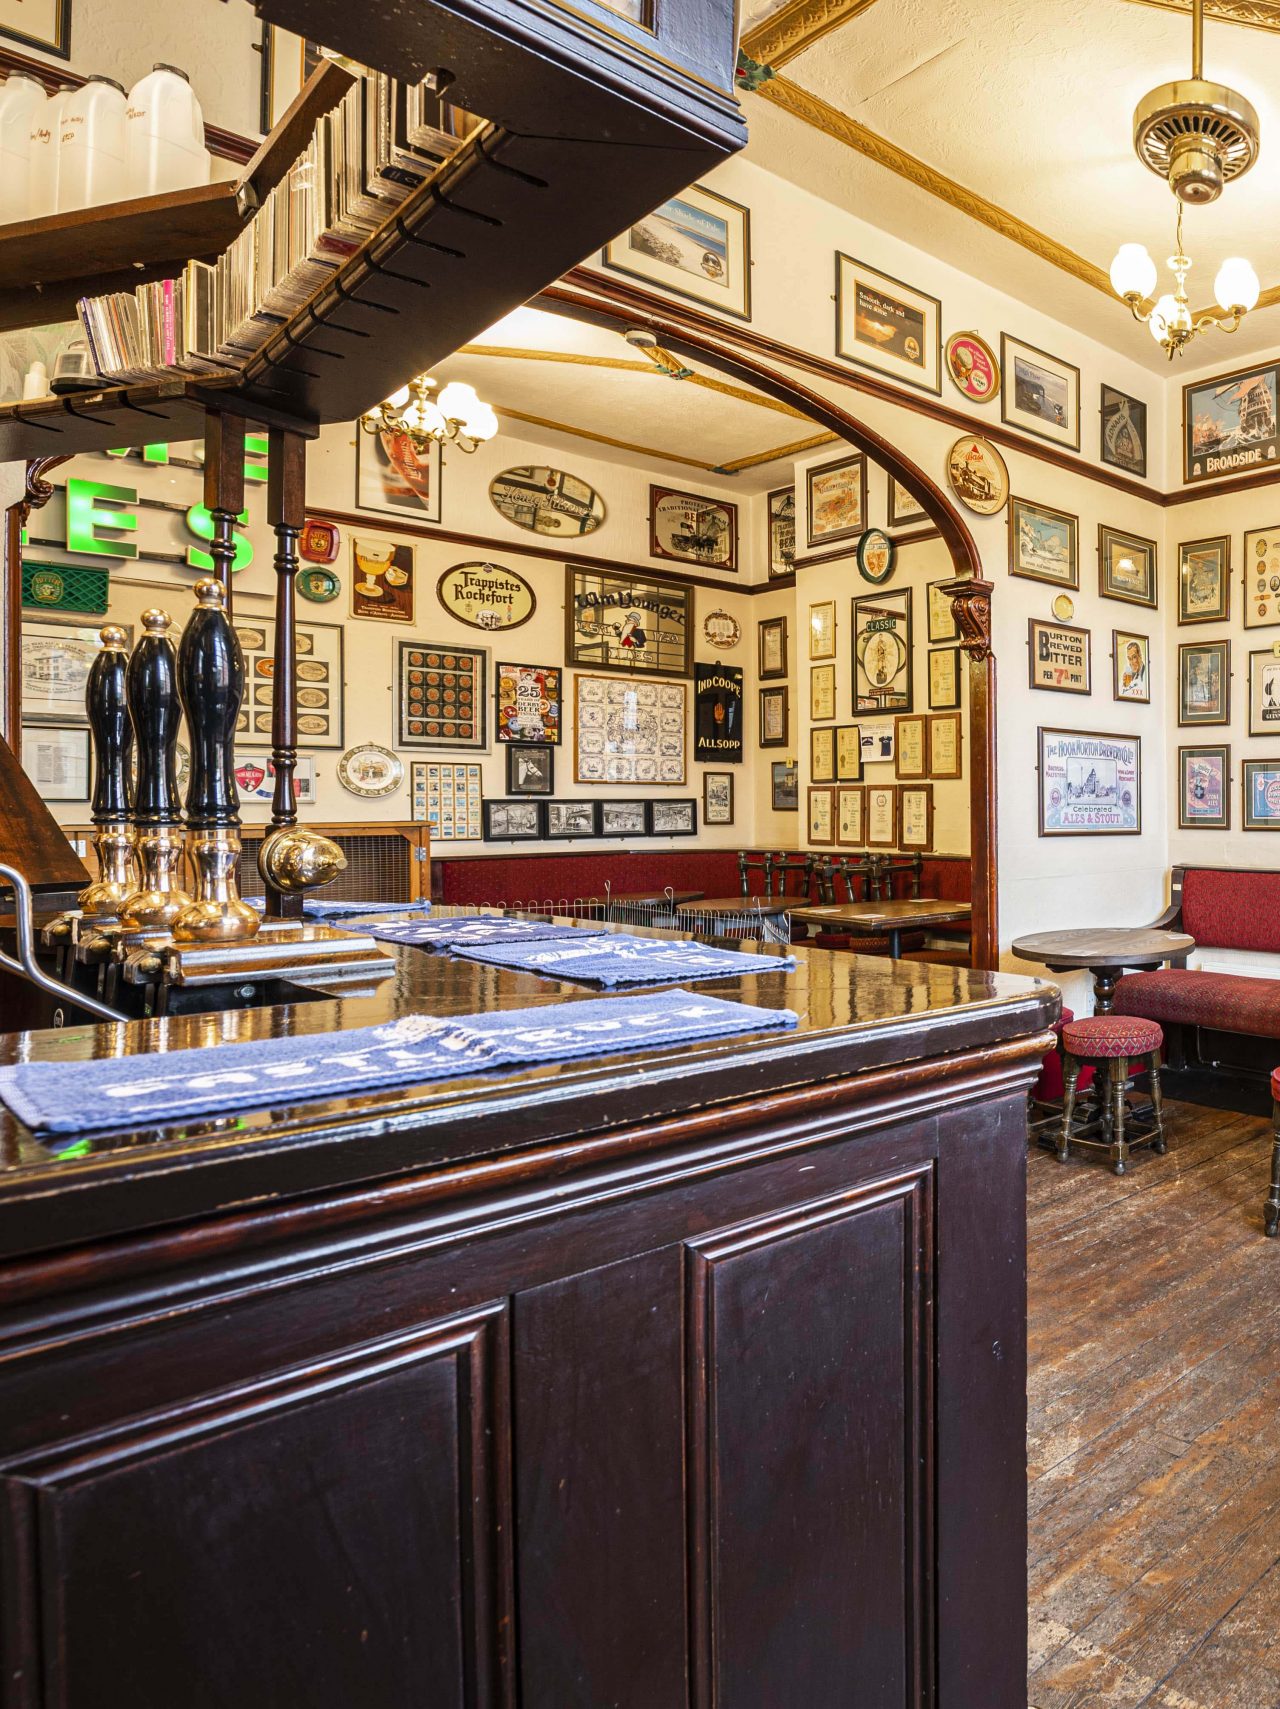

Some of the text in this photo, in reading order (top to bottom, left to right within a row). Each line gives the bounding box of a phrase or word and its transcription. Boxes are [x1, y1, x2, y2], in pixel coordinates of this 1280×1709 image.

[859, 298, 888, 317] have some
[882, 302, 895, 314] dark
[895, 309, 905, 318] and
[1107, 412, 1127, 442] ADNAMS
[1206, 448, 1263, 474] BROADSIDE
[658, 504, 700, 513] TRADITIONAL
[680, 499, 709, 510] PROTECT
[684, 511, 707, 524] BEER
[459, 571, 521, 593] Trappistes
[453, 583, 514, 606] Rochefort
[618, 591, 686, 621] Younger
[866, 618, 896, 632] CLASSIC
[1043, 670, 1054, 680] PER
[1070, 674, 1082, 684] PINT
[518, 685, 541, 698] 25
[698, 676, 741, 699] IND COOPE
[1132, 689, 1143, 697] XXX
[518, 706, 541, 714] BEER
[698, 736, 741, 749] ALLSOPP
[1046, 744, 1058, 758] THE
[1072, 805, 1113, 813] Celebrated
[1062, 812, 1121, 824] ALES & STOUT
[514, 1004, 723, 1044] ROCK
